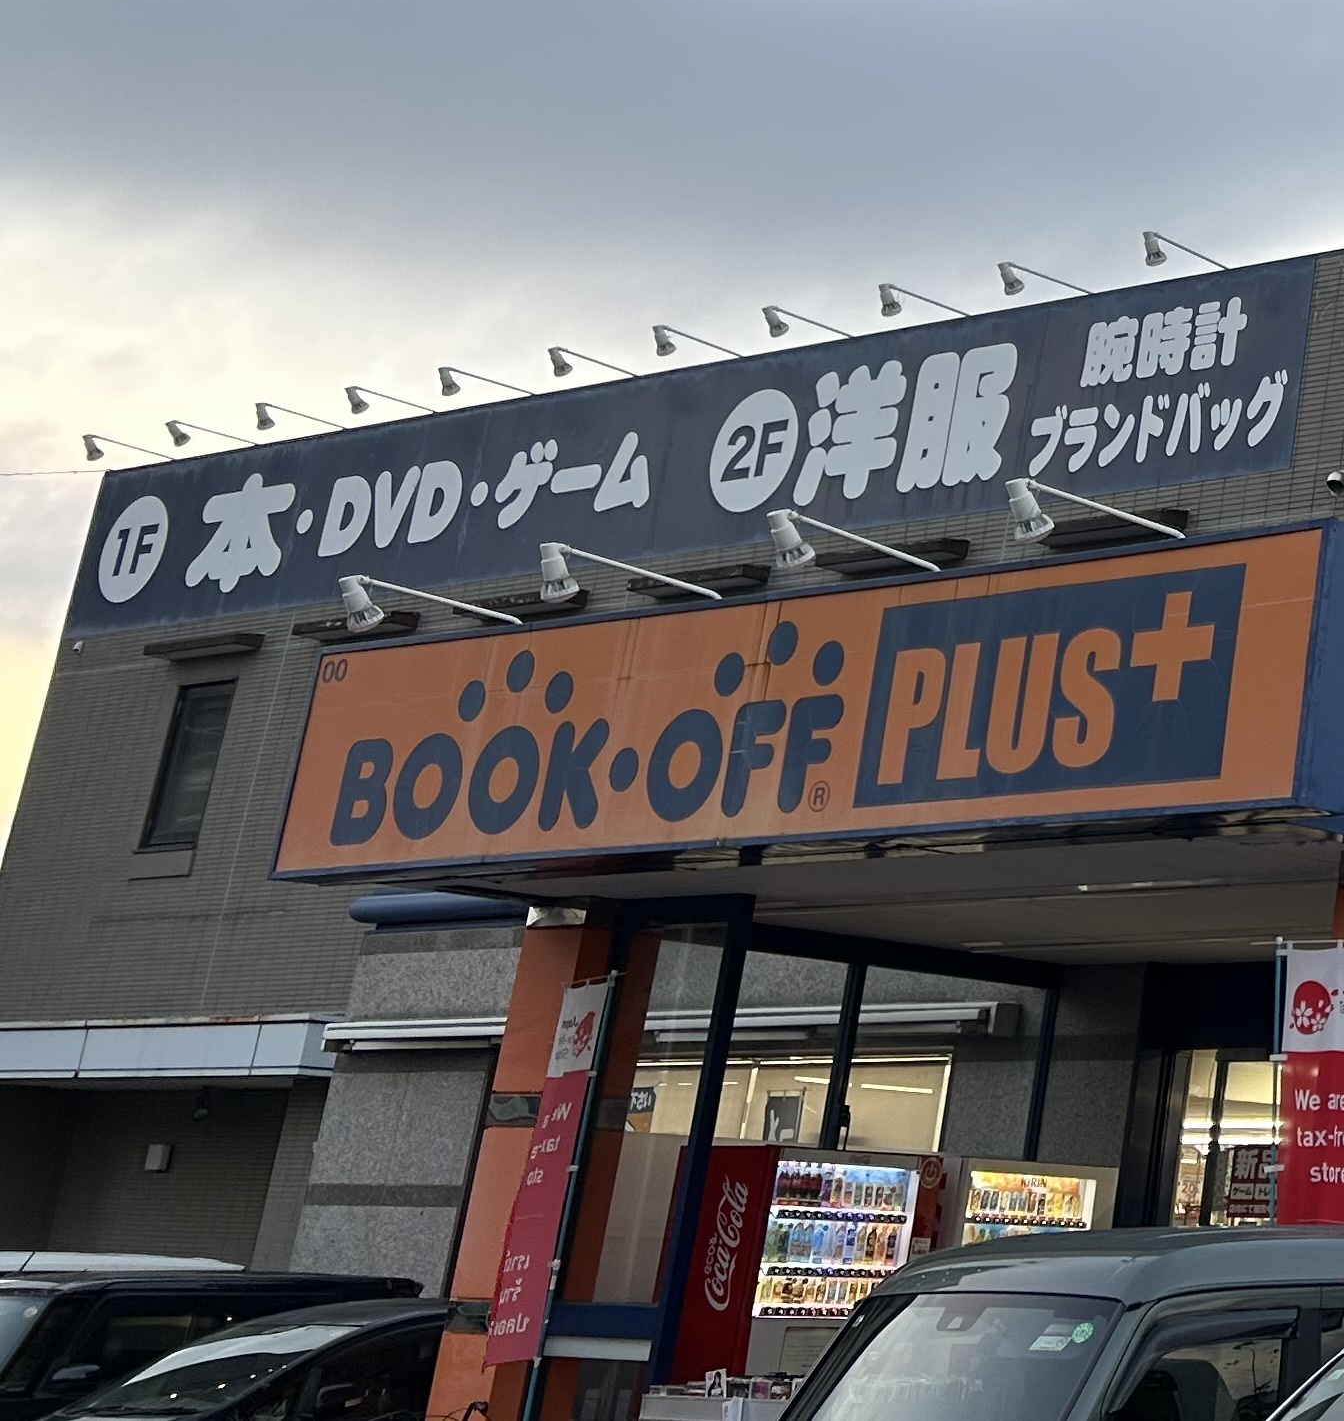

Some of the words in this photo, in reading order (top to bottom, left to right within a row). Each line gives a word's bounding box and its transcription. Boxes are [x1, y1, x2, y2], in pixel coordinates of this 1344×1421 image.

[1080, 296, 1248, 388] 腕時計
[720, 419, 790, 483] 2F
[793, 343, 1019, 506] 洋服
[1028, 370, 1289, 477] ブランドバッグ
[112, 526, 157, 579] 1F
[1294, 1088, 1321, 1111] We
[1021, 1178, 1048, 1188] KIRIN
[704, 1173, 749, 1312] Coca-Cola
